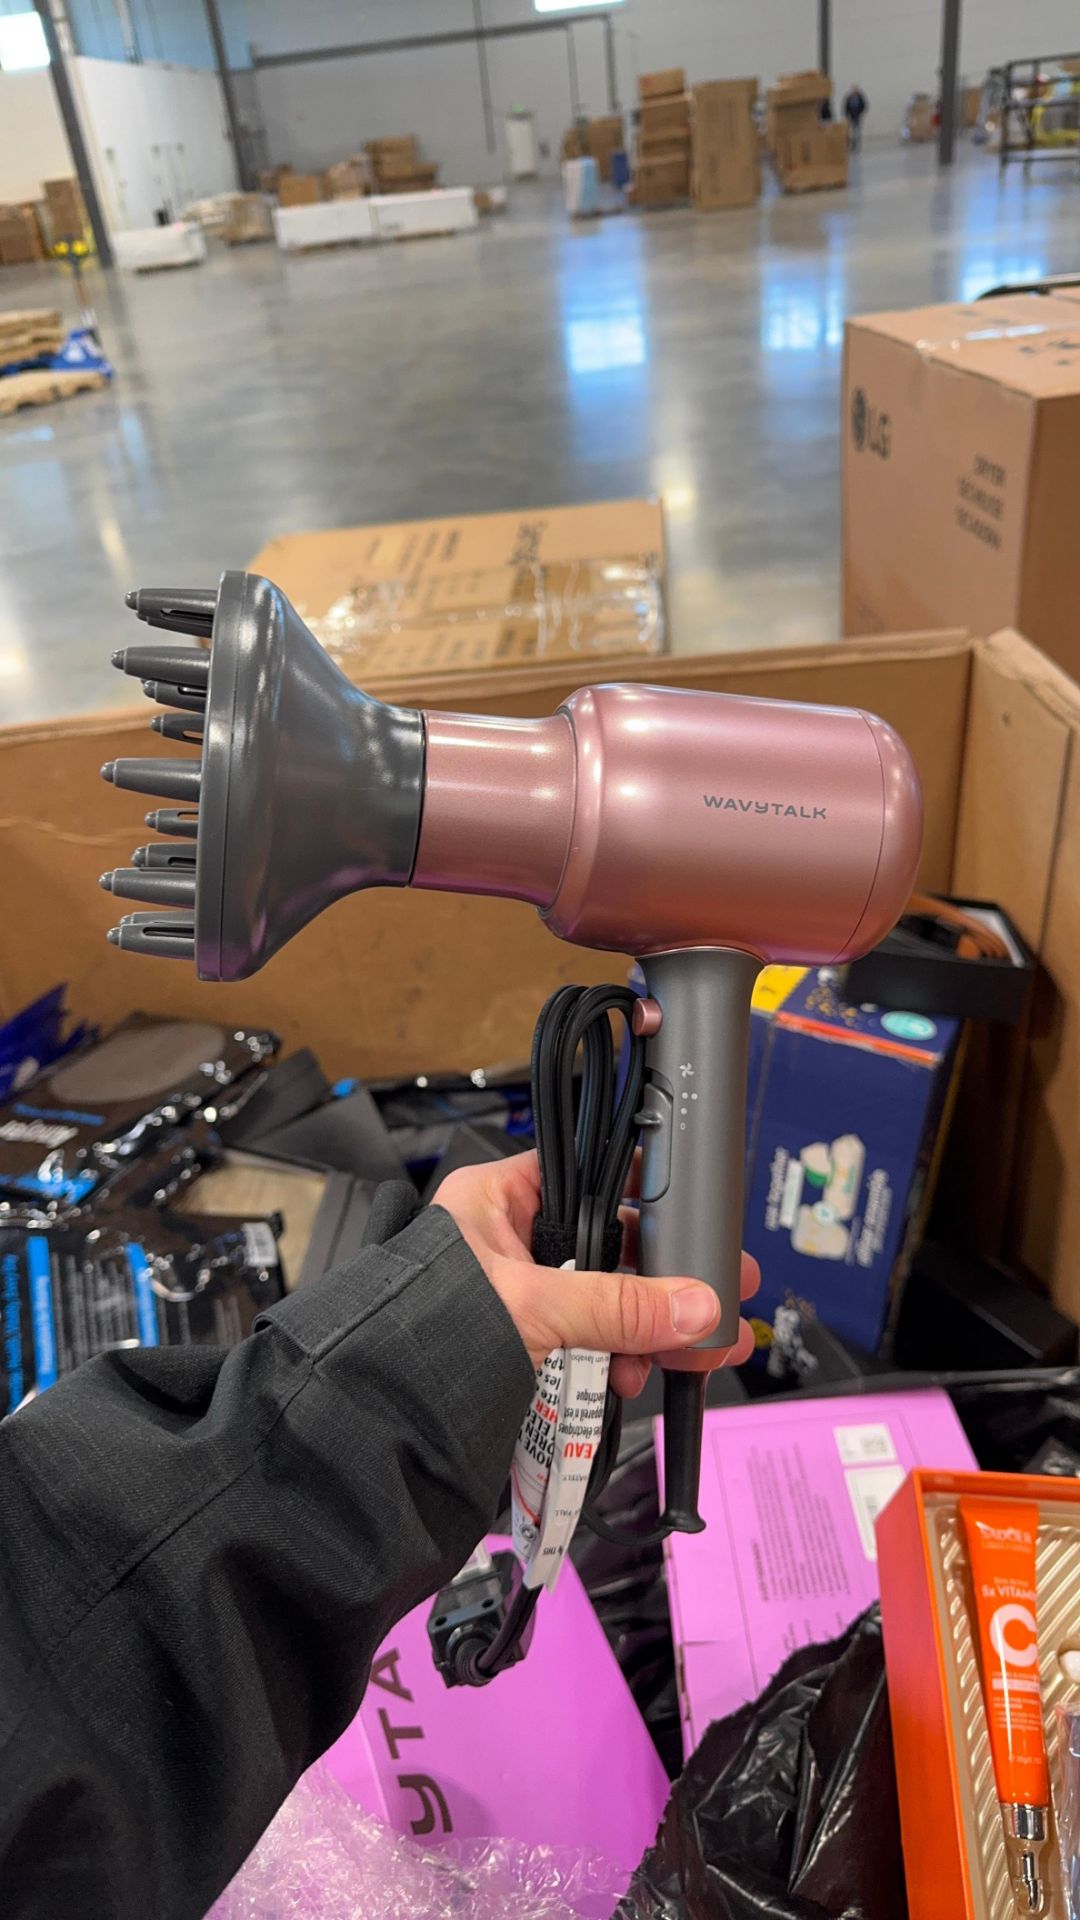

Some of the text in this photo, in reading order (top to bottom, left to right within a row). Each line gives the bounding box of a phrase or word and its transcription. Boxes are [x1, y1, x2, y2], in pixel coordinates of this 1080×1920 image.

[703, 794, 827, 820] WAVYTALK
[563, 1441, 593, 1459] EAU
[989, 1603, 1038, 1667] C
